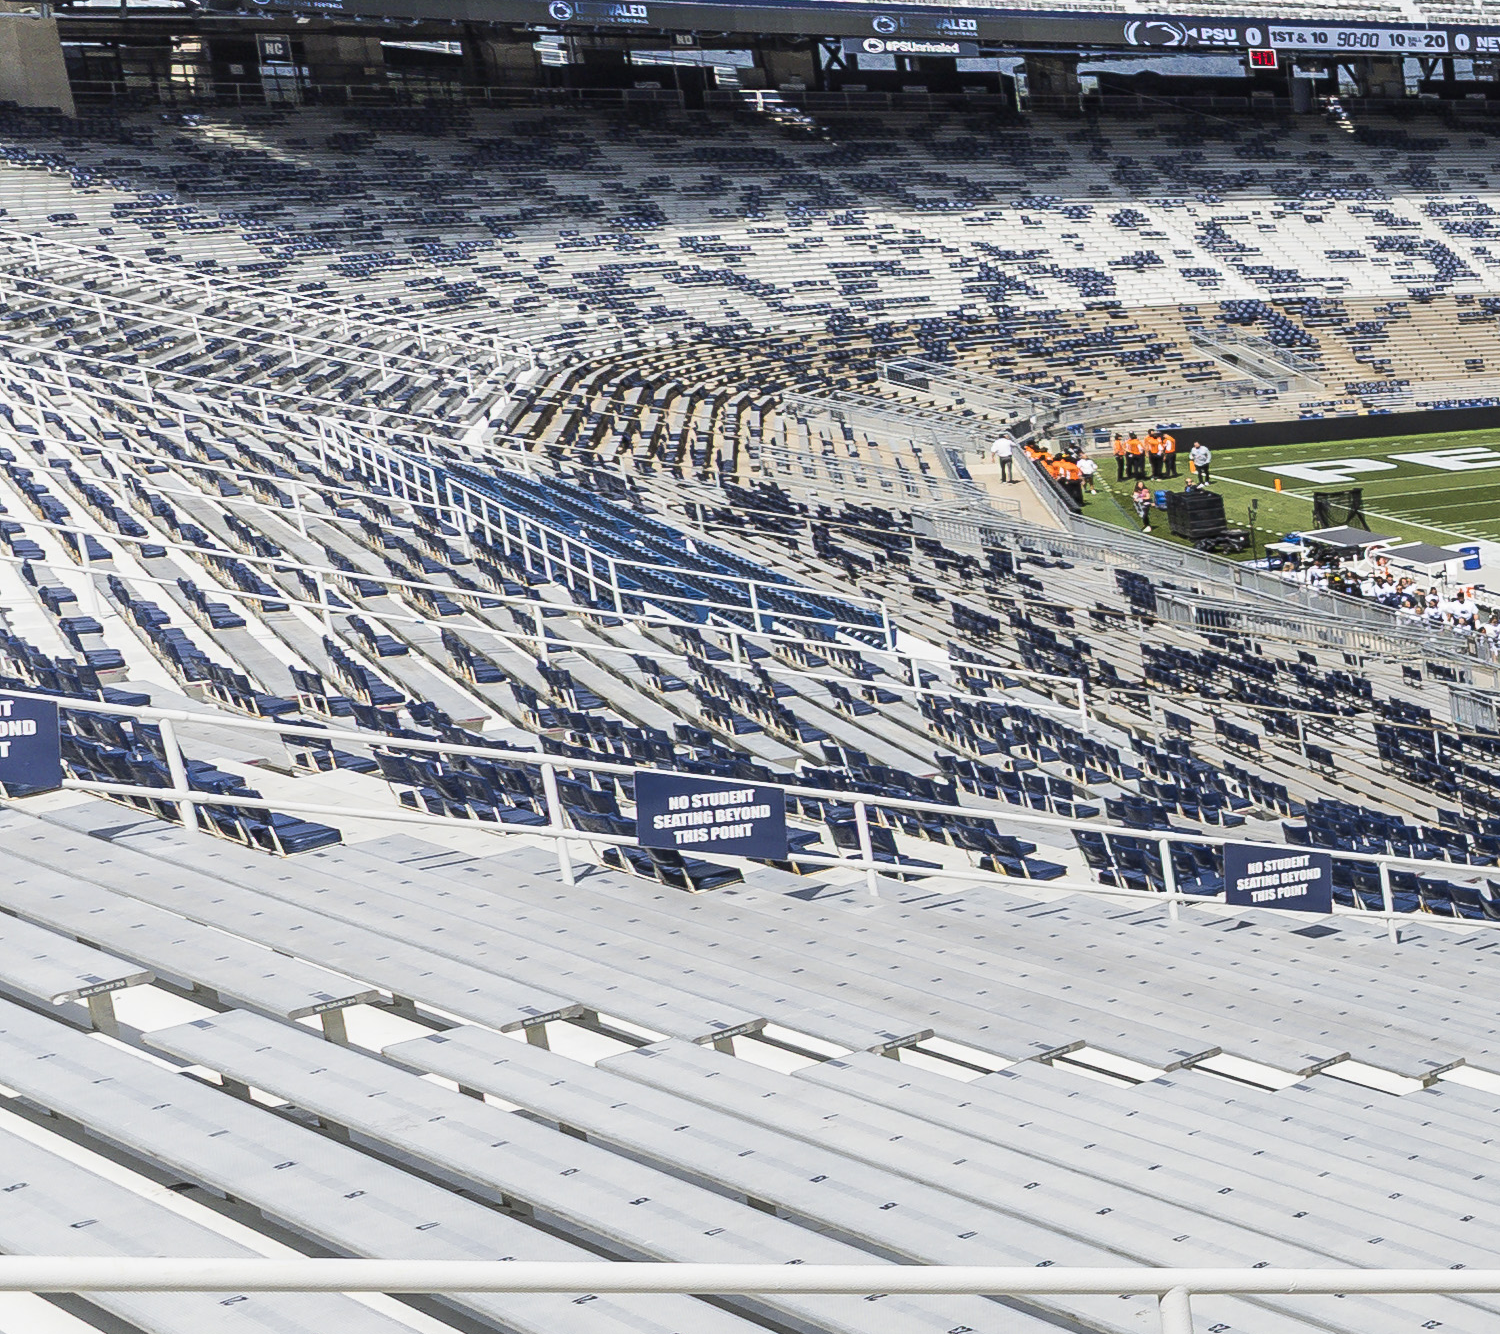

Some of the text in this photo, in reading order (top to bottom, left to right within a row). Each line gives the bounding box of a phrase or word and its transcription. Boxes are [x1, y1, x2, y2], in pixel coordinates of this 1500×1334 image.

[265, 42, 283, 55] NC
[1201, 27, 1238, 41] PSU
[1246, 27, 1263, 46] 0
[1271, 30, 1294, 44] 1ST
[1296, 31, 1309, 44] &
[1311, 31, 1328, 44] 10
[1337, 32, 1380, 48] 90:00
[1424, 33, 1446, 48] 20
[1455, 33, 1470, 51] 0
[670, 789, 756, 812] NO STUDENT
[655, 803, 771, 830] SEATING BEYOND
[674, 822, 754, 845] THIS POINT
[1247, 855, 1309, 874] NO STUDENT
[1236, 867, 1321, 891] SEATING BEYOND
[1250, 882, 1307, 903] THIS POINT
